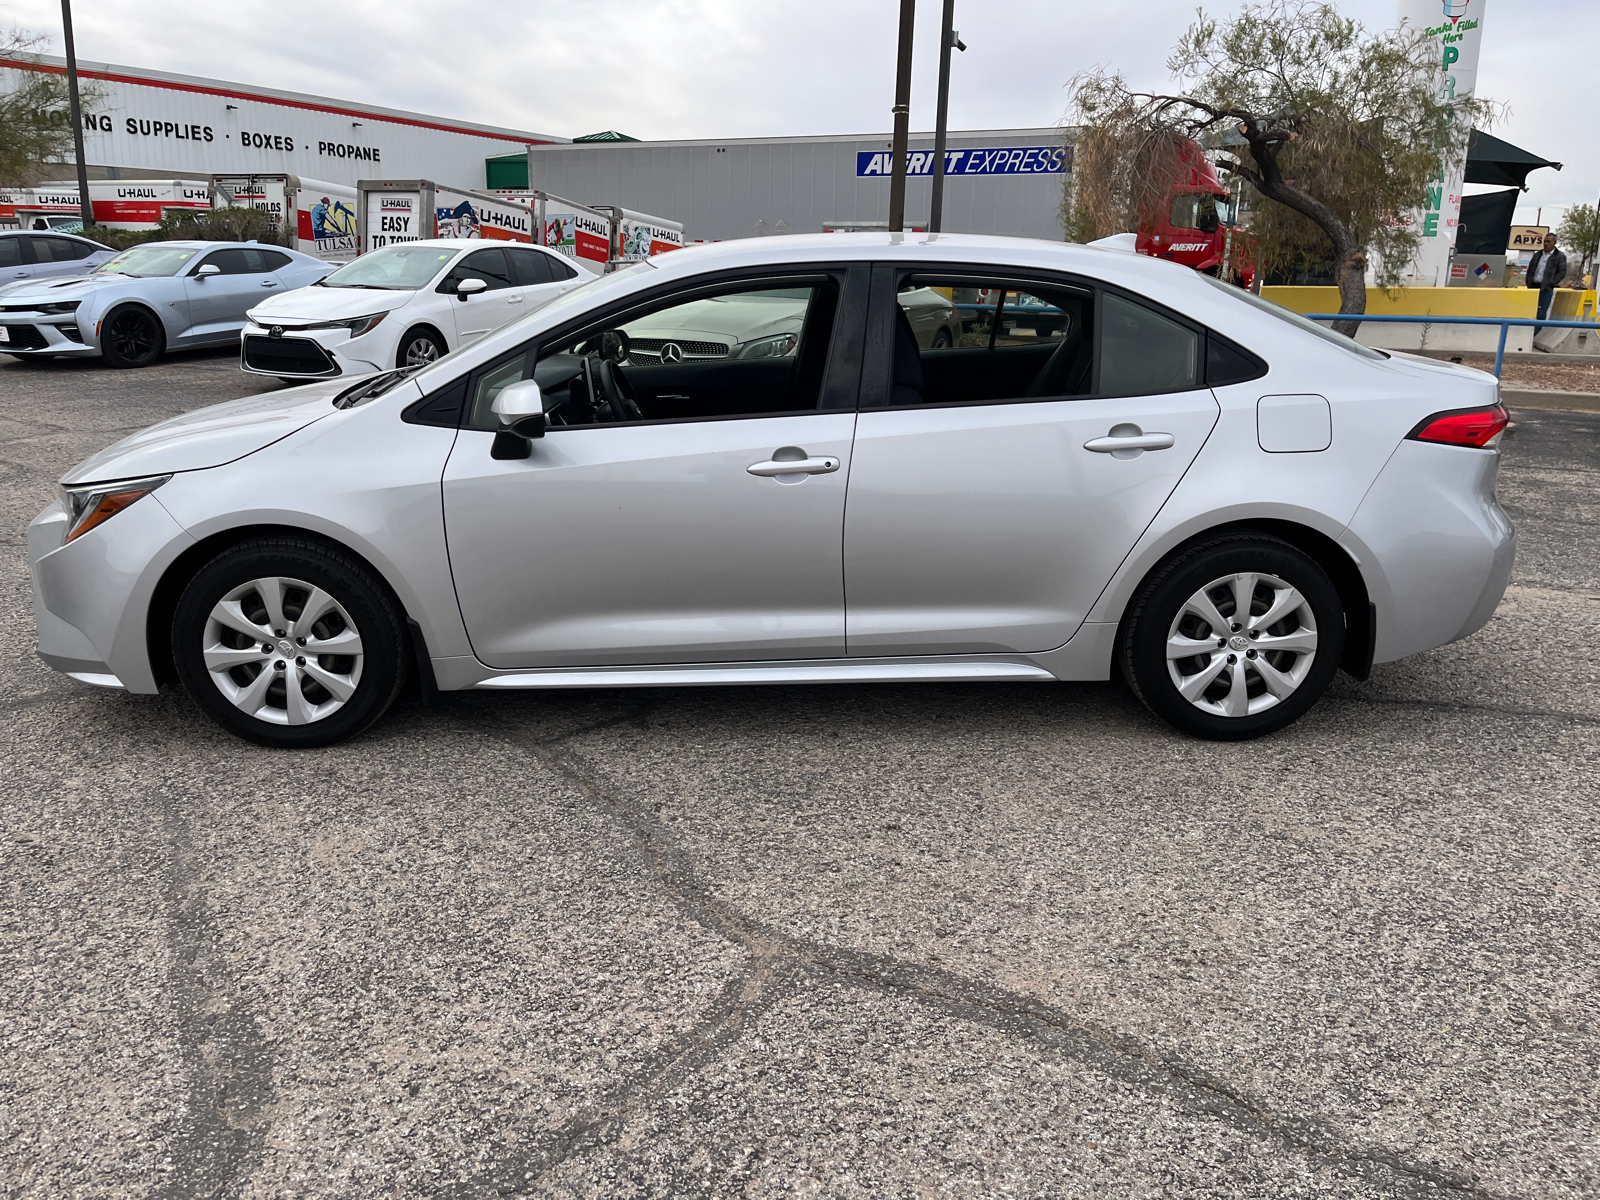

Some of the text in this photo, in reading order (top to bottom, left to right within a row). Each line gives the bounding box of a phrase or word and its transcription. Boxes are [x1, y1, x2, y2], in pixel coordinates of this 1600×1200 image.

[1424, 18, 1479, 38] Tanks Filled
[1442, 33, 1464, 45] Here
[126, 117, 214, 142] SUPPLIES
[241, 131, 294, 152] BOXES
[318, 141, 381, 162] PROPANE
[863, 149, 1067, 174] AVRIT EXPRESS
[117, 189, 157, 198] U-HAUL
[255, 203, 281, 212] HOLDS
[381, 200, 411, 208] U-HAUL
[381, 216, 410, 232] EASY
[480, 208, 528, 232] U-HAUL
[575, 216, 608, 237] U-HAUL
[372, 235, 386, 249] TO
[652, 228, 680, 243] U-HAUL
[315, 237, 355, 251] TULSA
[1168, 243, 1208, 252] AVERITT
